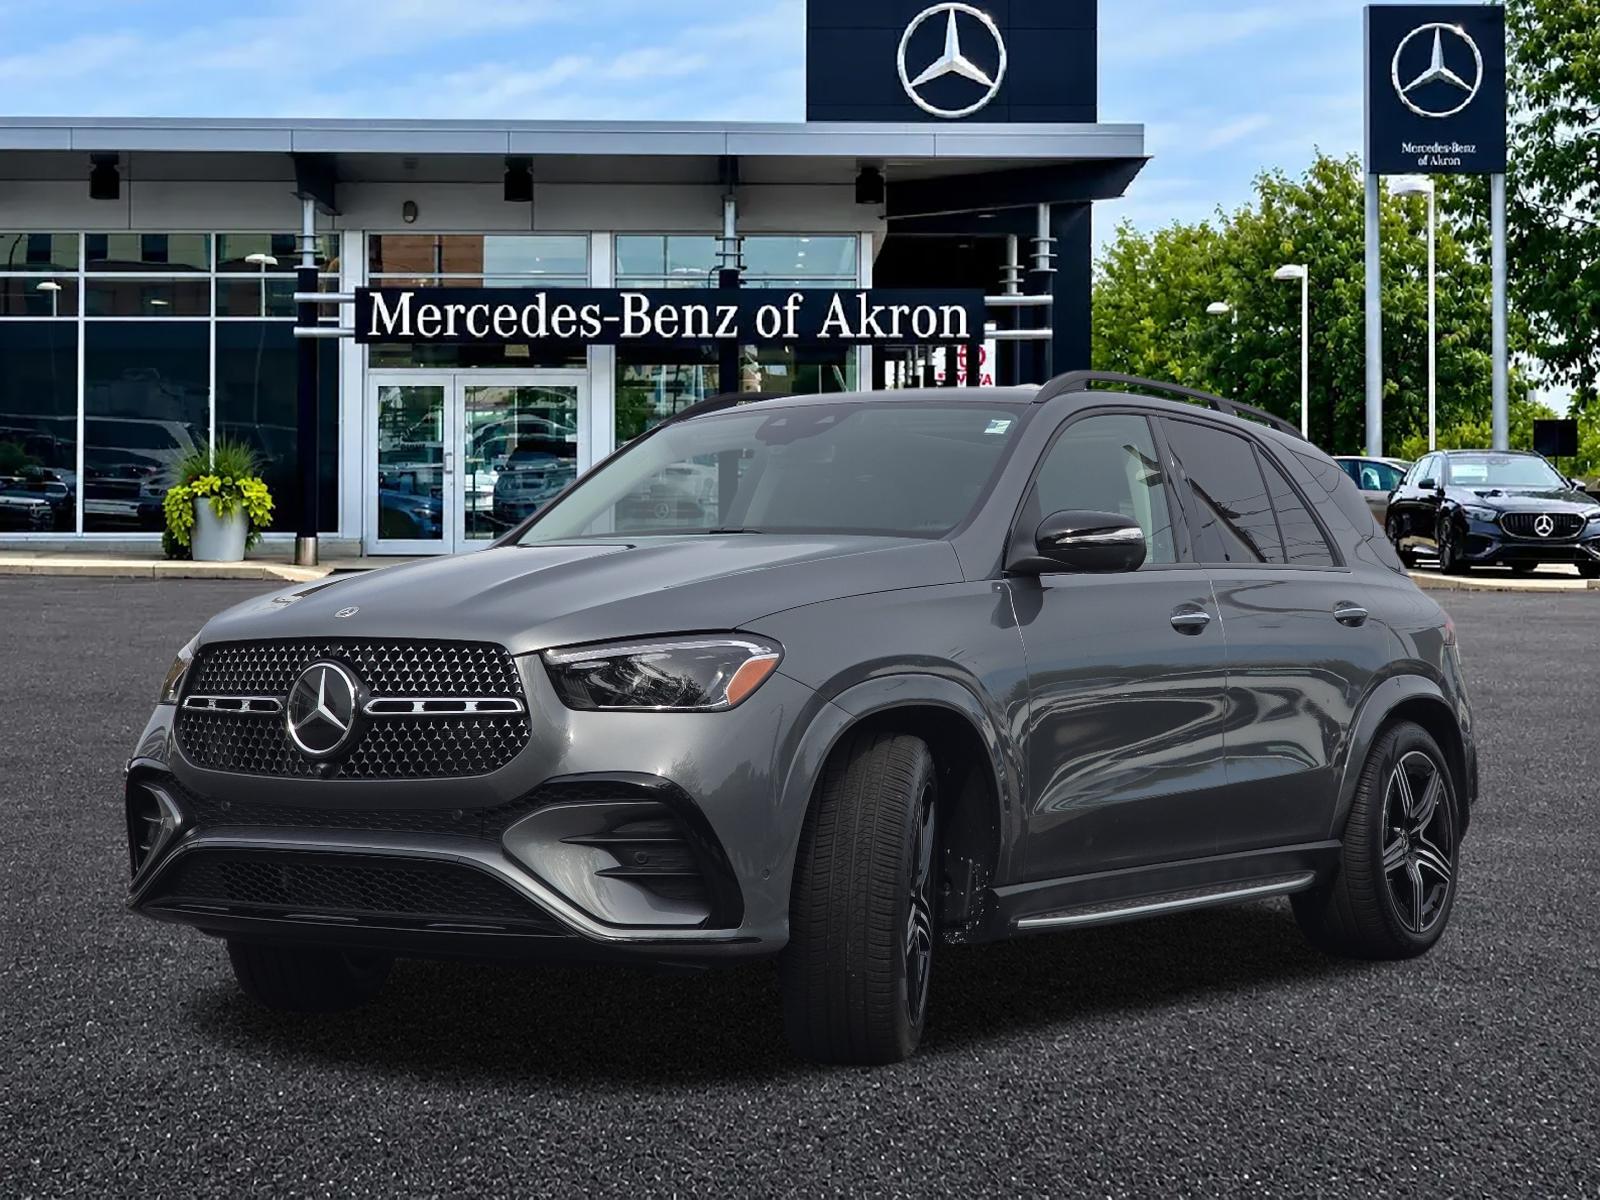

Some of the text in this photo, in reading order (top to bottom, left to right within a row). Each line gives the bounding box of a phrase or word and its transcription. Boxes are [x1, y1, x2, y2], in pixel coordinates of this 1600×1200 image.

[1417, 154, 1461, 166] of Akron
[367, 290, 971, 338] Mercedes-Benz of Akron
